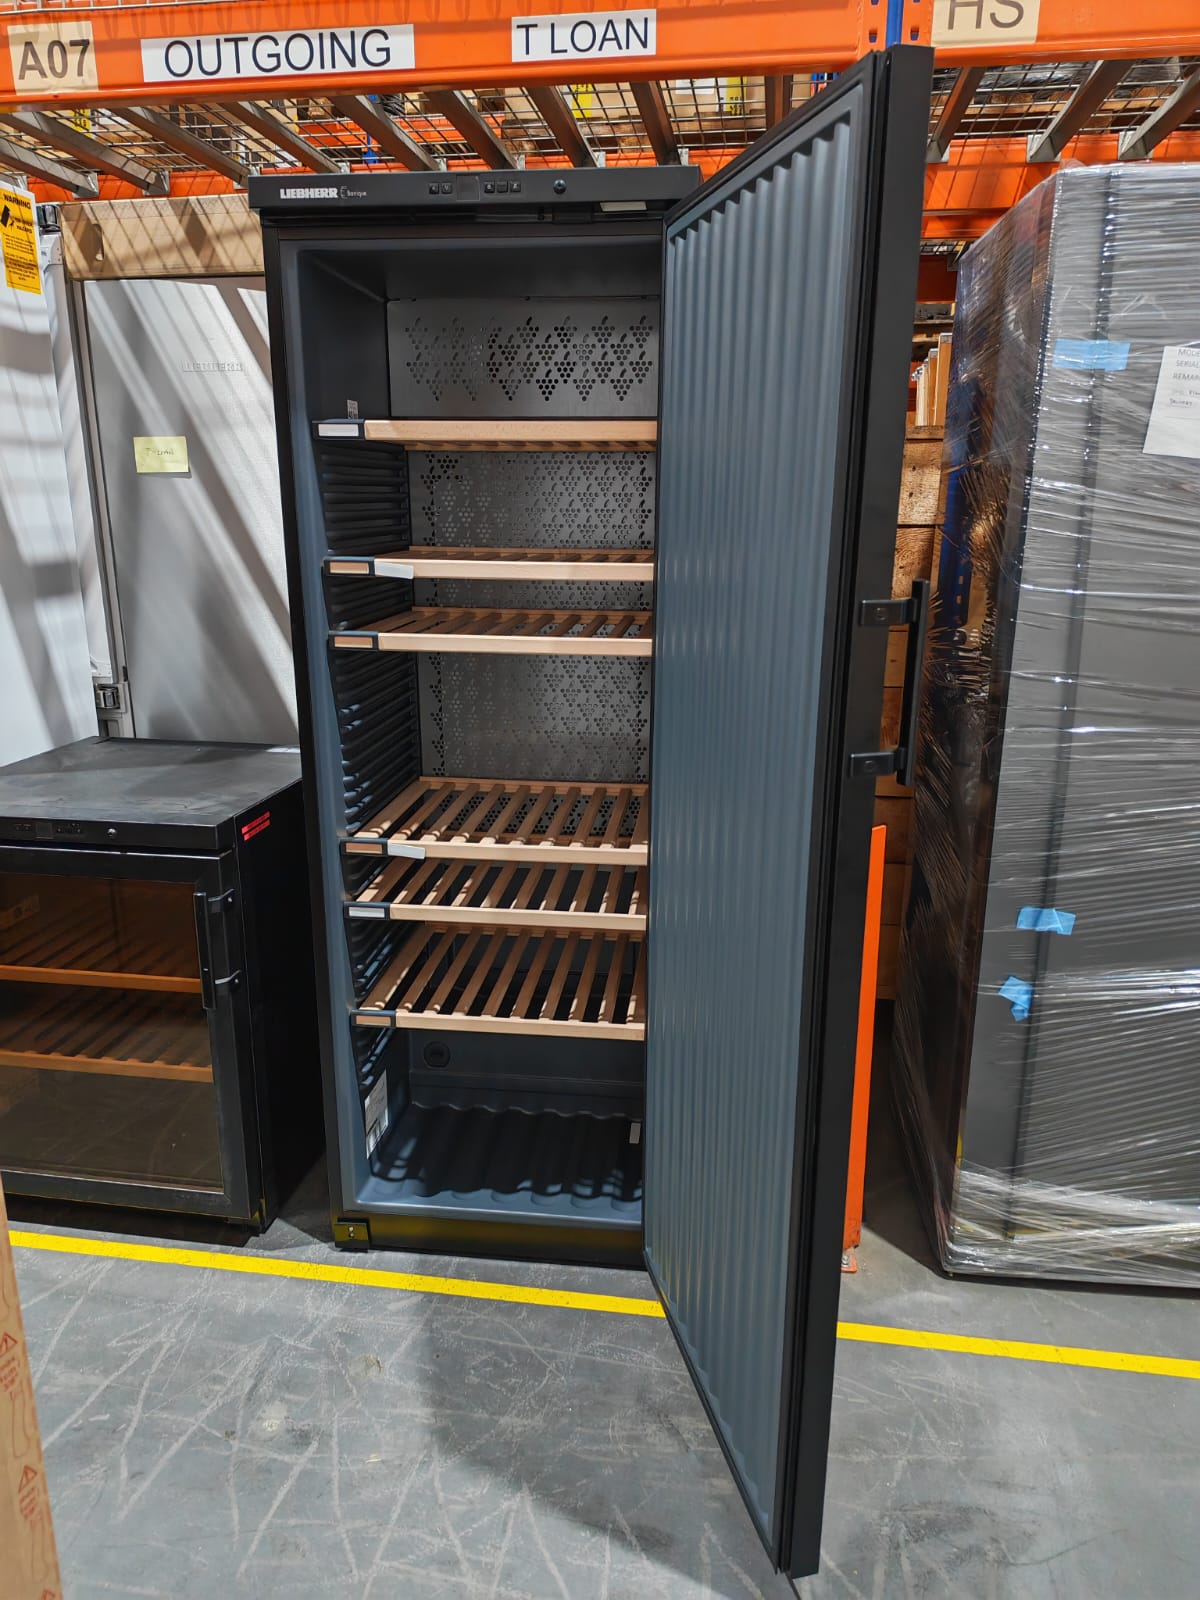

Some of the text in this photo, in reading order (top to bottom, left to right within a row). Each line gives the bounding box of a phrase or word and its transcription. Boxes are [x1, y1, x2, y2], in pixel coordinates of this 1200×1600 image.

[164, 29, 391, 77] OUTGOING
[516, 17, 648, 55] T LOAN
[18, 39, 91, 80] A07
[3, 194, 31, 209] WARNING
[280, 187, 338, 199] LIEBHERR
